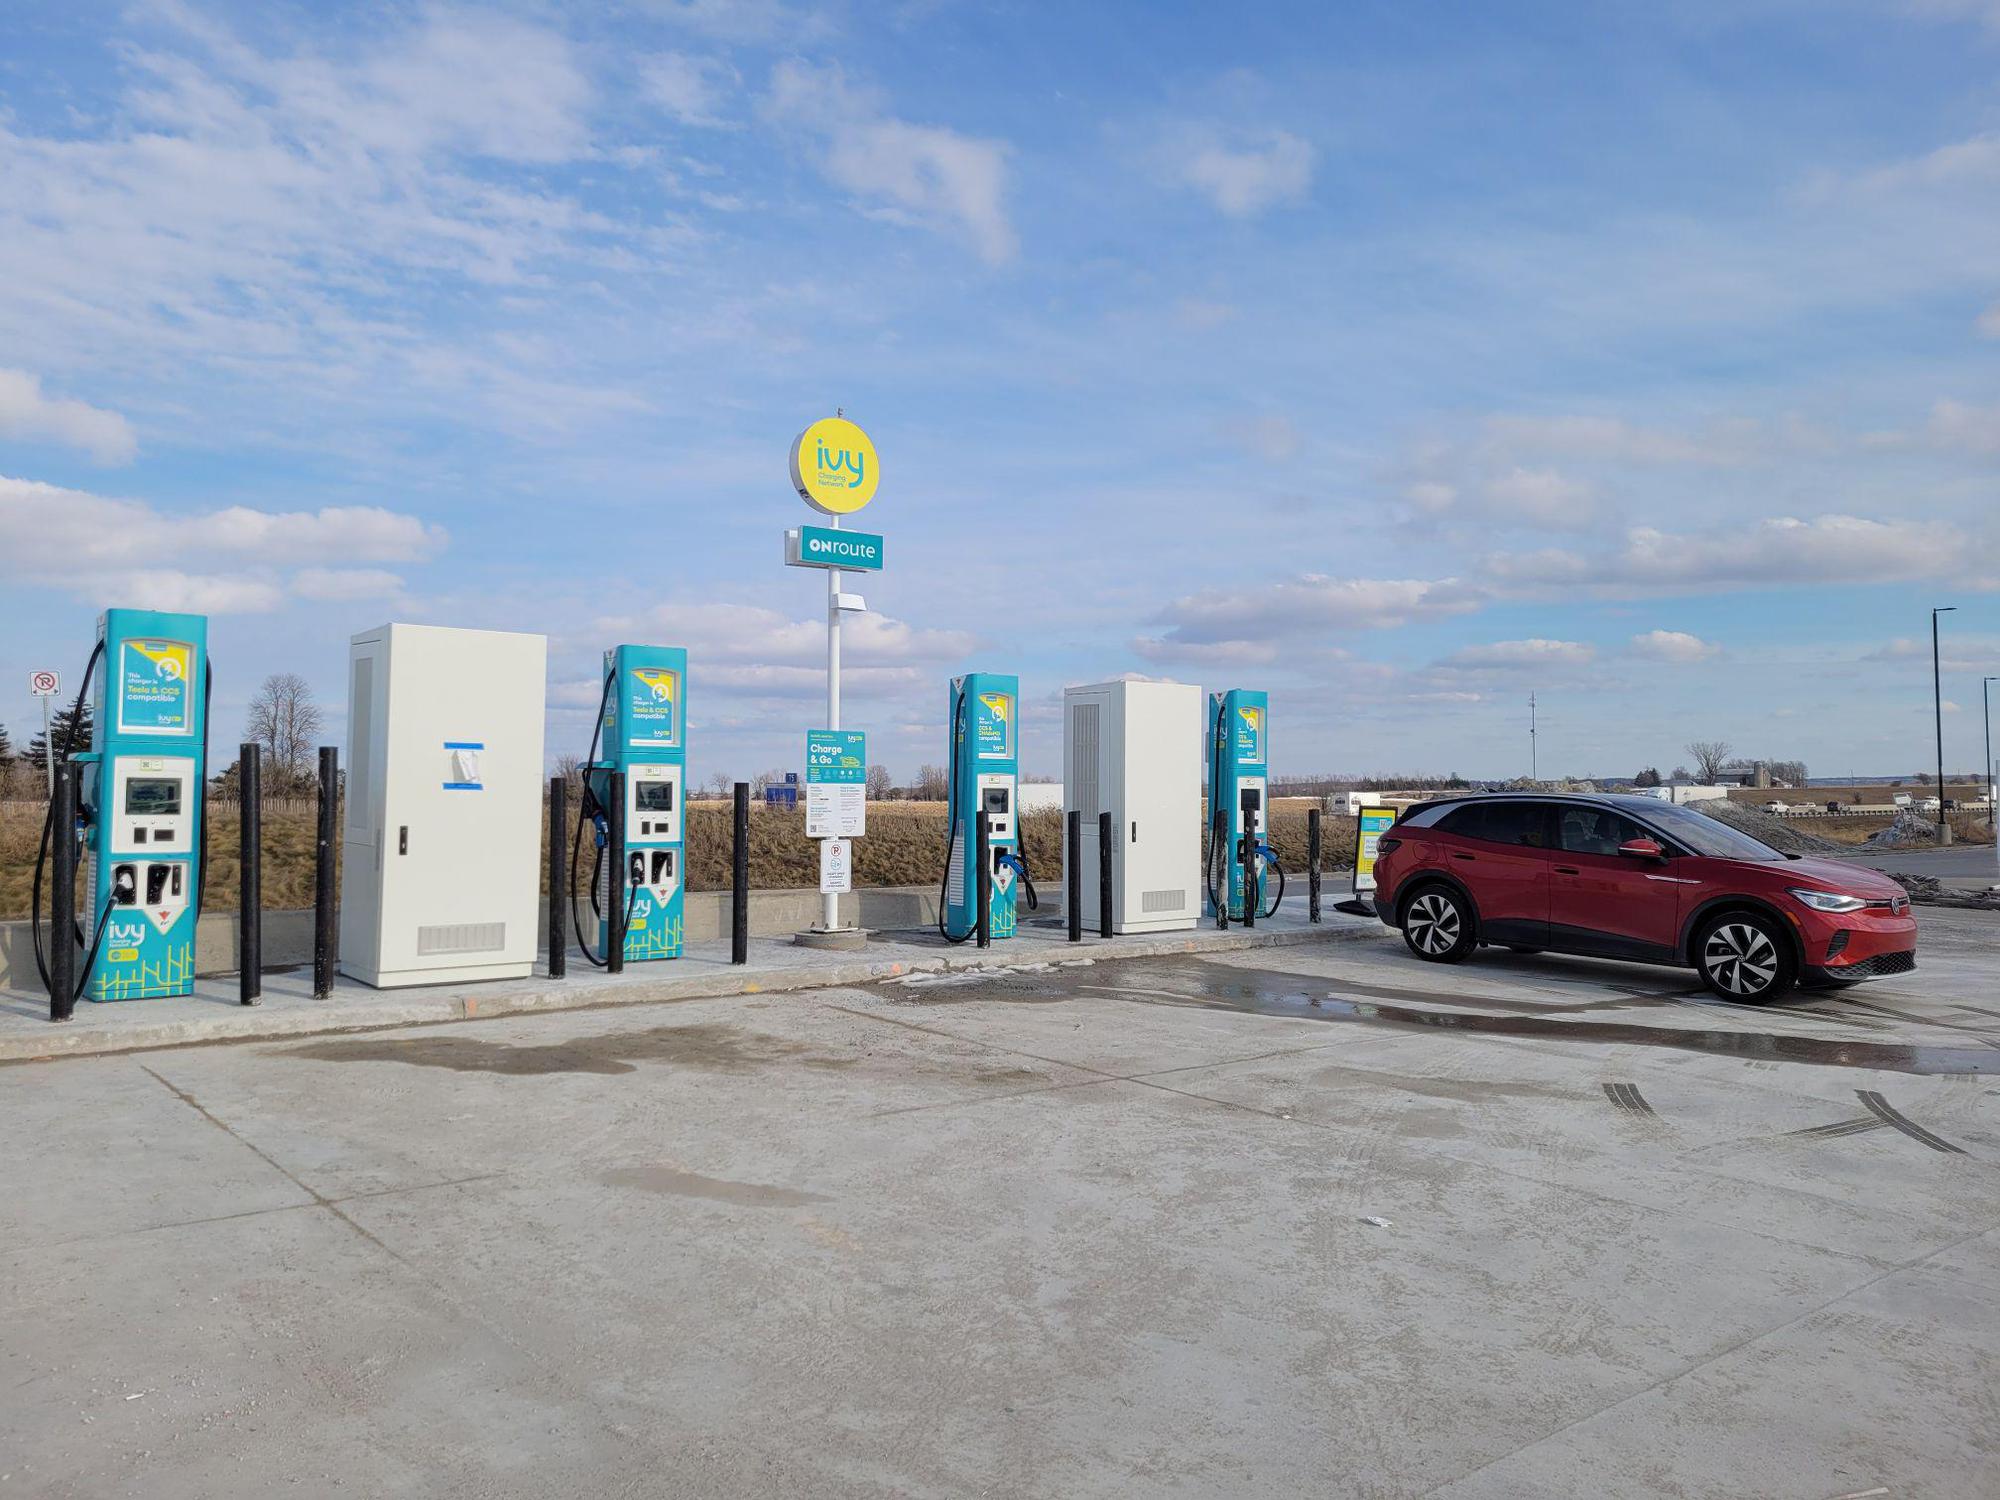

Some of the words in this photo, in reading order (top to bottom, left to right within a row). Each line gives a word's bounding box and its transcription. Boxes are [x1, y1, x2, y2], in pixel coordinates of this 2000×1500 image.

[817, 438, 864, 488] ivy
[818, 472, 847, 482] Charging
[818, 480, 844, 488] Network
[809, 539, 875, 558] ONroute
[127, 685, 150, 693] Tesla
[161, 687, 180, 696] CCS
[127, 694, 177, 702] compatible
[810, 743, 842, 755] Charge
[810, 755, 818, 764] &
[820, 755, 832, 764] Go
[109, 920, 146, 947] ivy
